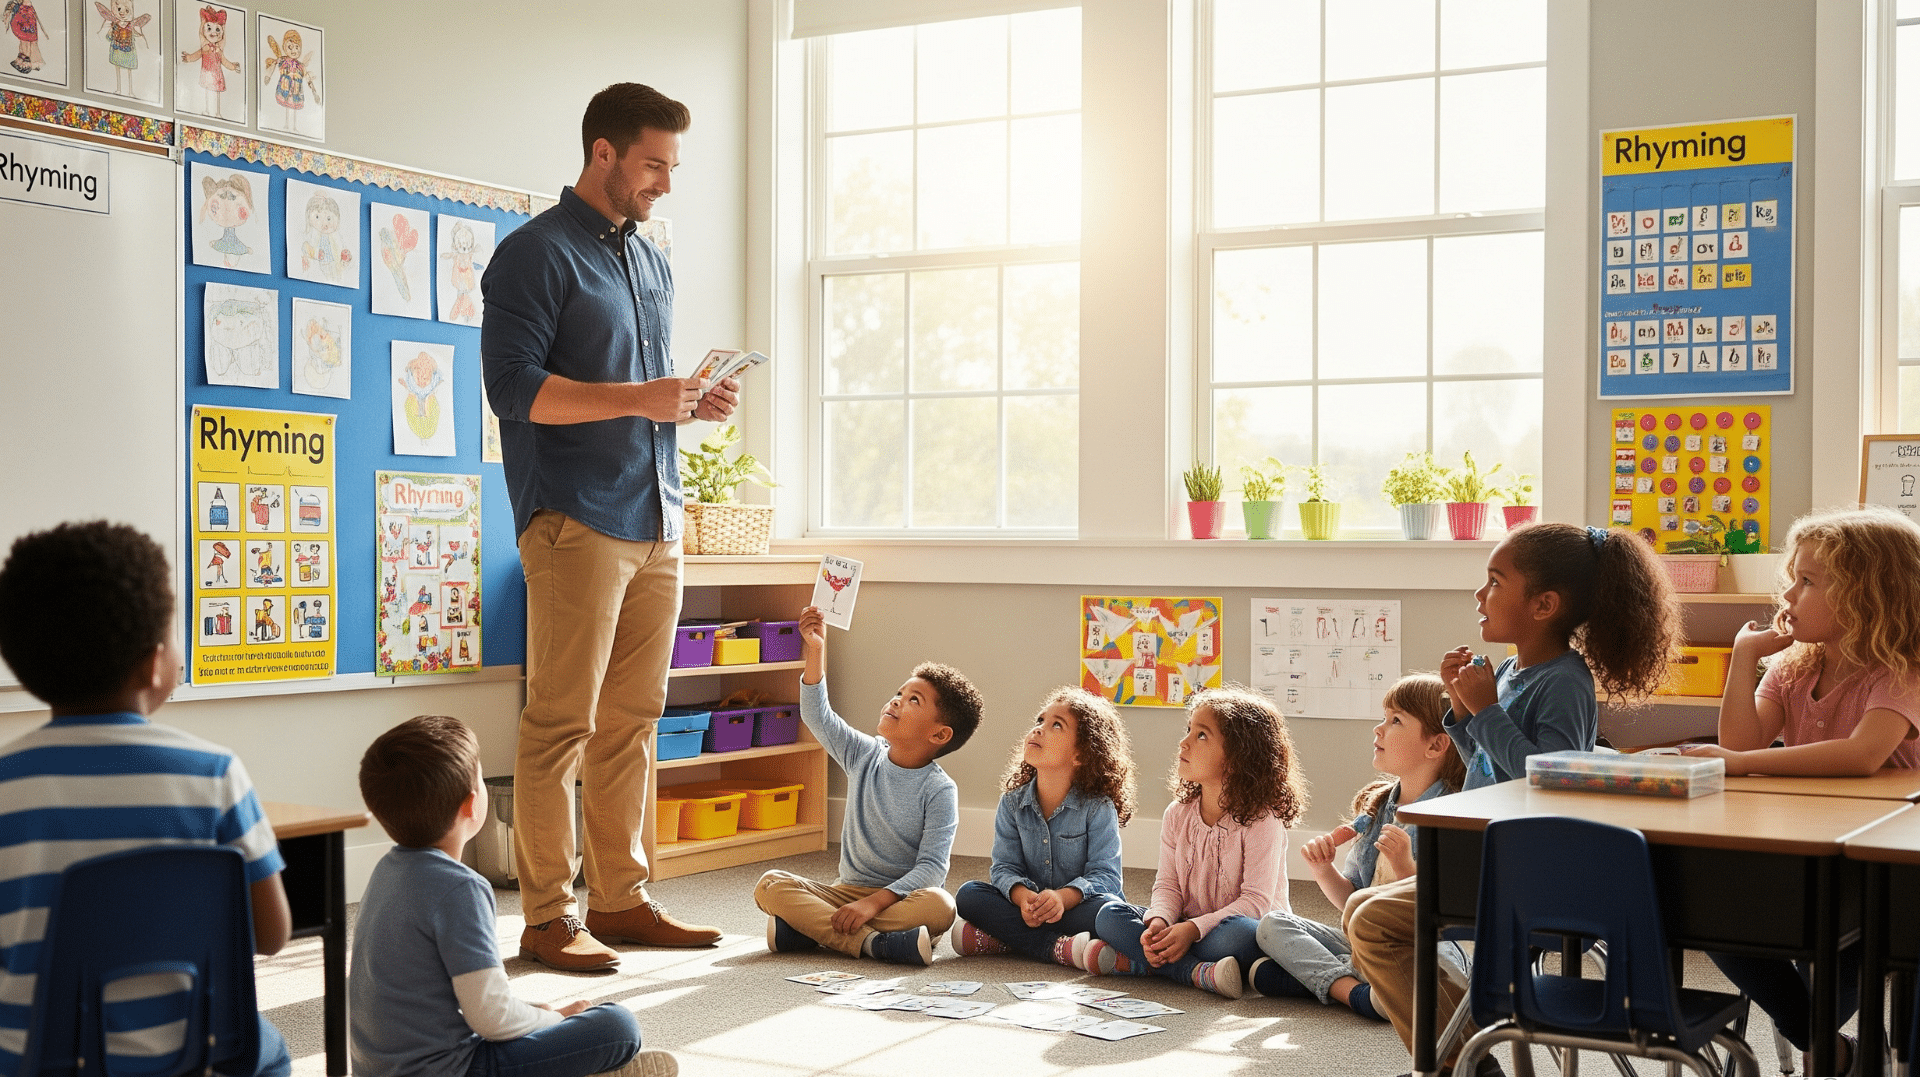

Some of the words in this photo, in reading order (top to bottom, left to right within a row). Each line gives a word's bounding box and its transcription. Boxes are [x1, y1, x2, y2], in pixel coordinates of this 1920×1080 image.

[1615, 131, 1746, 169] Rhyming
[200, 415, 325, 464] Rhyming
[394, 483, 464, 509] Rhyming
